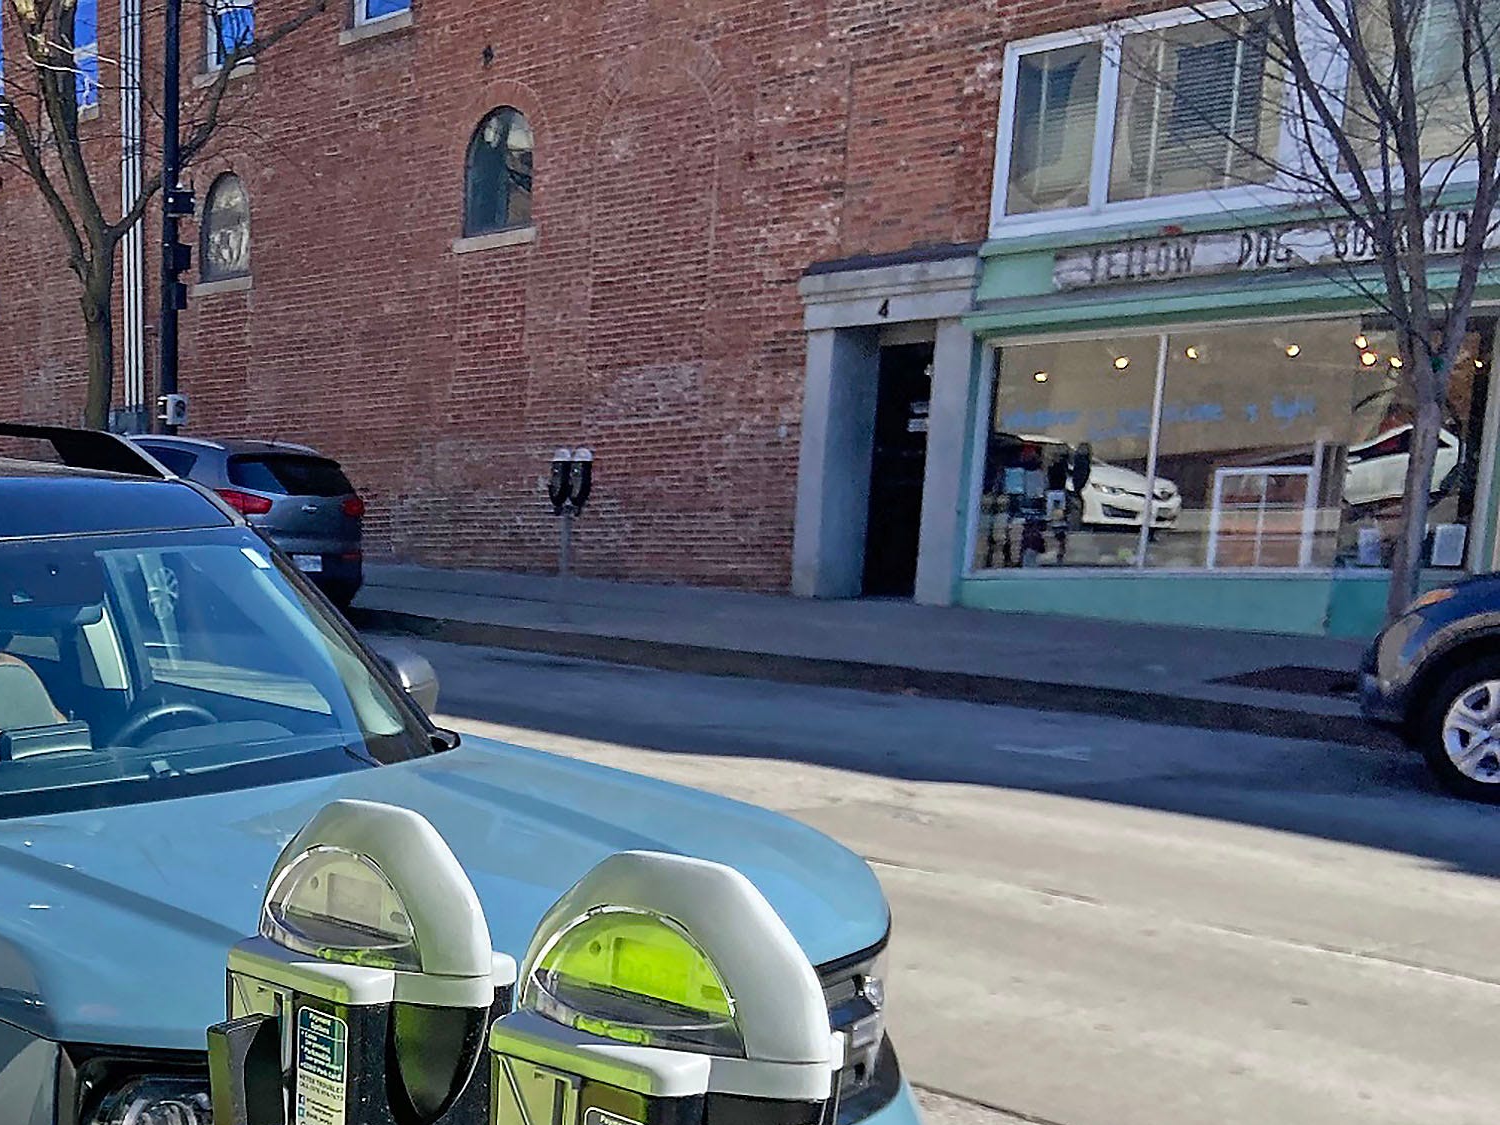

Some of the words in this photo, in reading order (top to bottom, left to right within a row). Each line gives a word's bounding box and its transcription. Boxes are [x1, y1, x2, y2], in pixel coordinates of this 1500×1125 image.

[1091, 240, 1196, 282] YELLOW
[1238, 231, 1293, 267] DOG
[878, 299, 889, 318] 4
